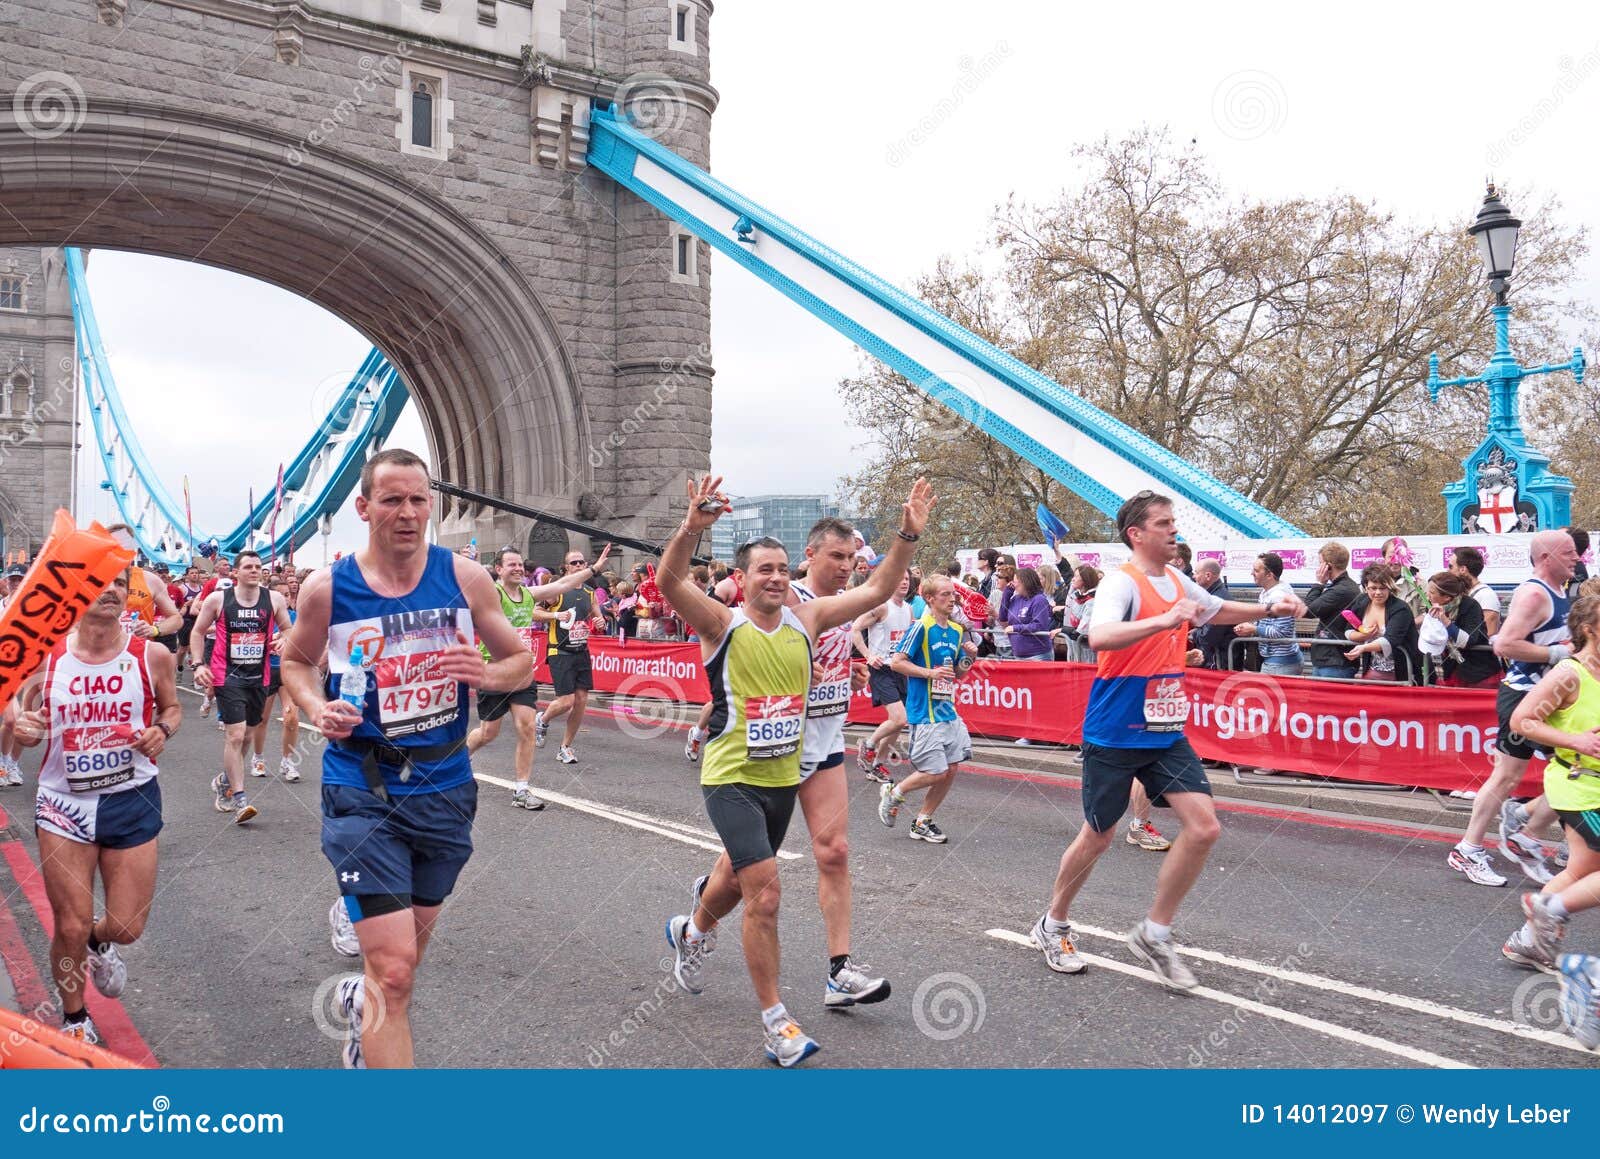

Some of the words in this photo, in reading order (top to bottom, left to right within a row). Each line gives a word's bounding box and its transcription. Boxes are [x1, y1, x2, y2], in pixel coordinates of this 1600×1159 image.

[237, 609, 260, 618] NEIL
[623, 654, 696, 680] marathon
[69, 675, 123, 695] CIAO
[809, 682, 848, 702] 56815
[383, 681, 457, 714] 47973
[58, 702, 132, 725] THOMAS
[416, 710, 457, 732] adidas
[1279, 701, 1425, 749] london
[74, 726, 116, 751] Virgin
[748, 718, 801, 741] 56822
[66, 749, 133, 773] 56809
[91, 772, 133, 788] adidas
